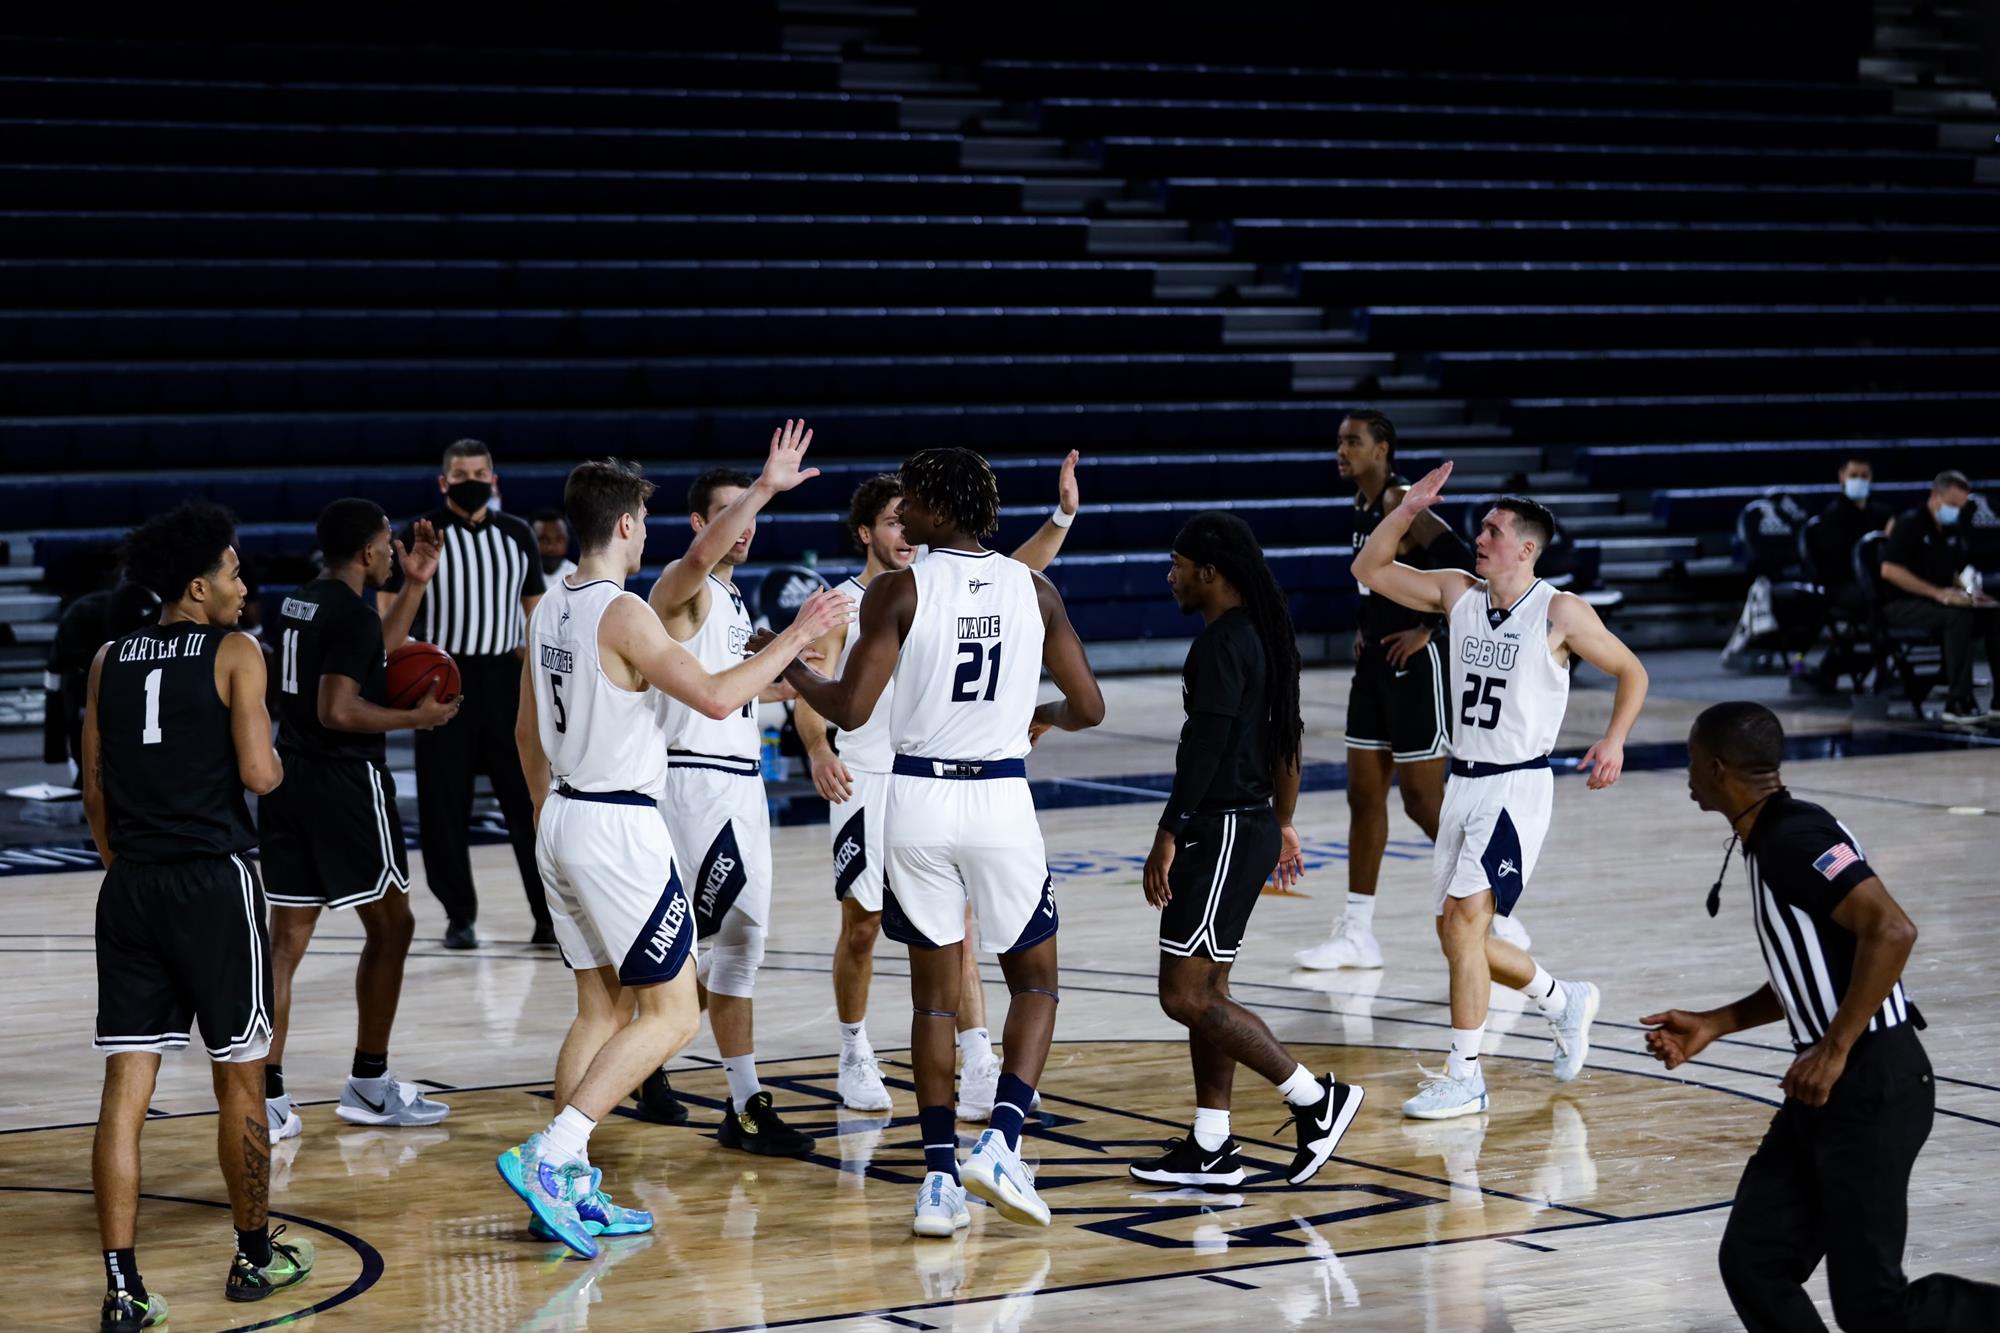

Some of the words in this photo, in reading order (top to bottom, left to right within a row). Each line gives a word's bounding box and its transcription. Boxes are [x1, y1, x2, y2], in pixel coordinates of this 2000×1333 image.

[119, 636, 179, 662] CARTER
[183, 633, 207, 656] III
[957, 615, 1000, 639] WADE
[1461, 635, 1519, 671] CBU
[282, 628, 299, 694] 11
[951, 641, 1002, 702] 21
[143, 668, 162, 744] 1
[550, 673, 566, 734] 5
[1461, 672, 1507, 730] 25
[698, 852, 736, 918] LANCERS
[645, 892, 688, 964] LANCERS
